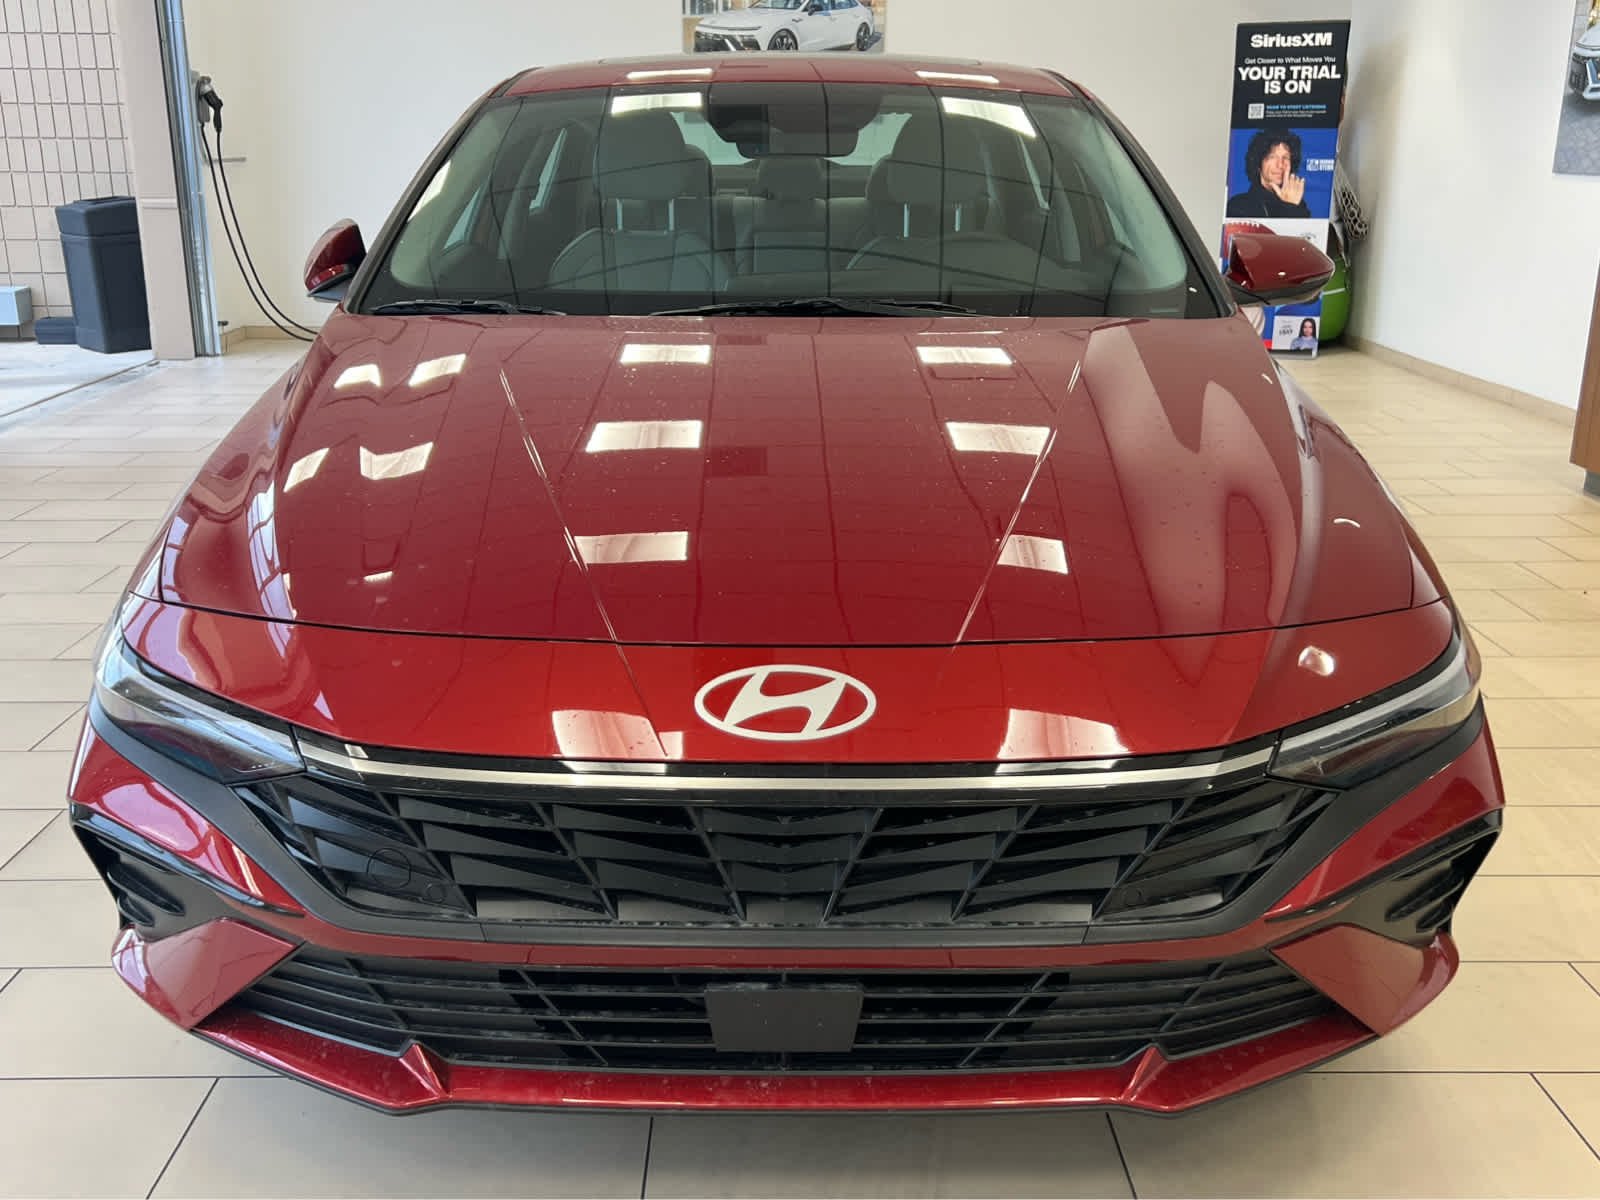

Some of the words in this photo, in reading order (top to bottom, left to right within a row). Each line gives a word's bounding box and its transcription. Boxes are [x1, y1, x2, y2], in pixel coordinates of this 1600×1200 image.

[1250, 32, 1333, 48] SiriusXM
[1238, 66, 1287, 81] YOUR
[1289, 65, 1341, 80] TRIAL
[1264, 80, 1281, 94] IS
[1284, 79, 1311, 94] ON
